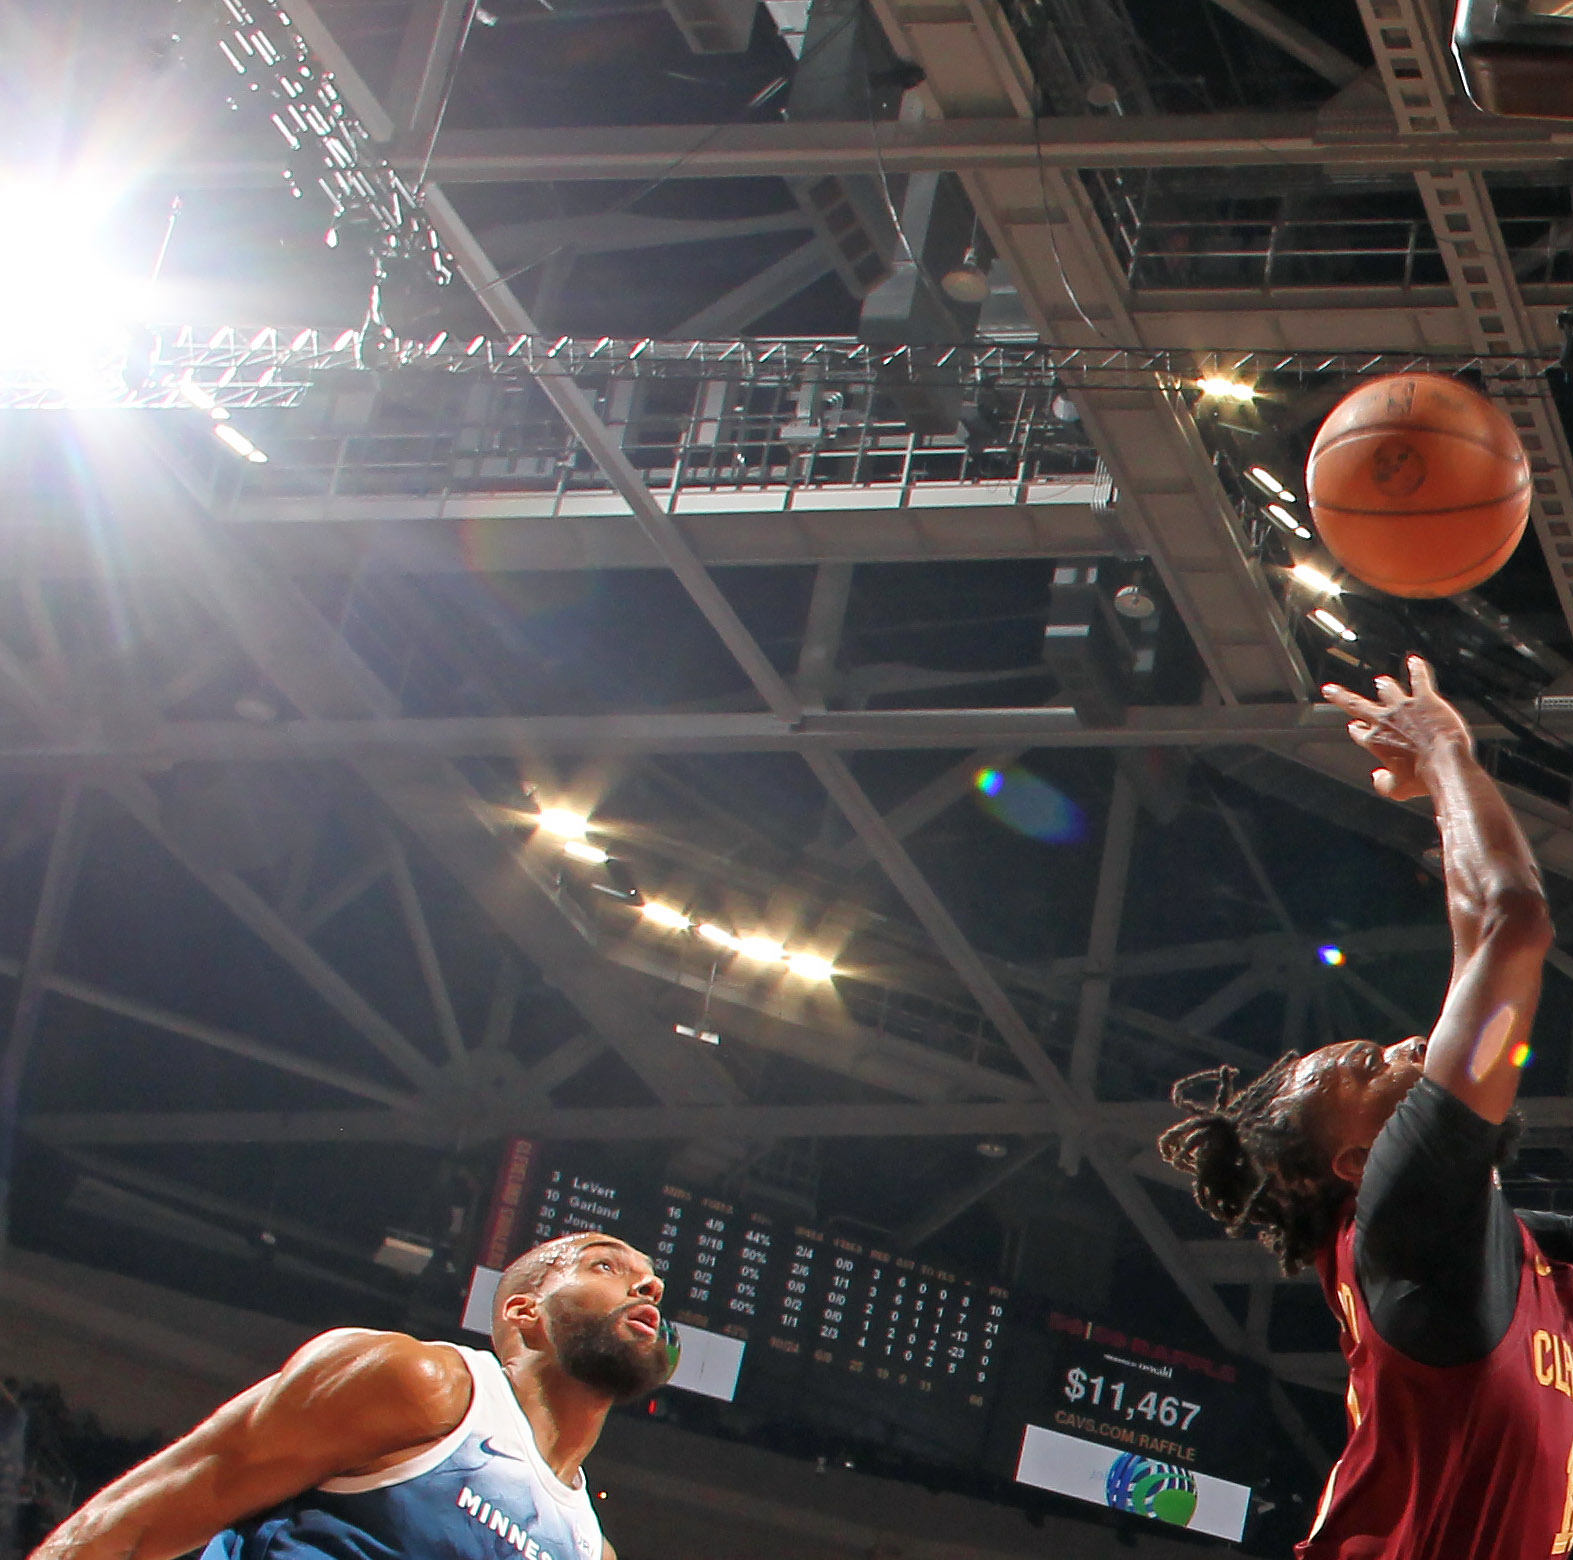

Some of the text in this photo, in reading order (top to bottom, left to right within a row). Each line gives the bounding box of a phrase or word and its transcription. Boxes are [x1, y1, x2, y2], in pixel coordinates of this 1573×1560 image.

[572, 1178, 615, 1201] LeVert
[568, 1195, 619, 1222] Garland
[564, 1213, 603, 1231] Jones
[1064, 1367, 1201, 1431] $11,467
